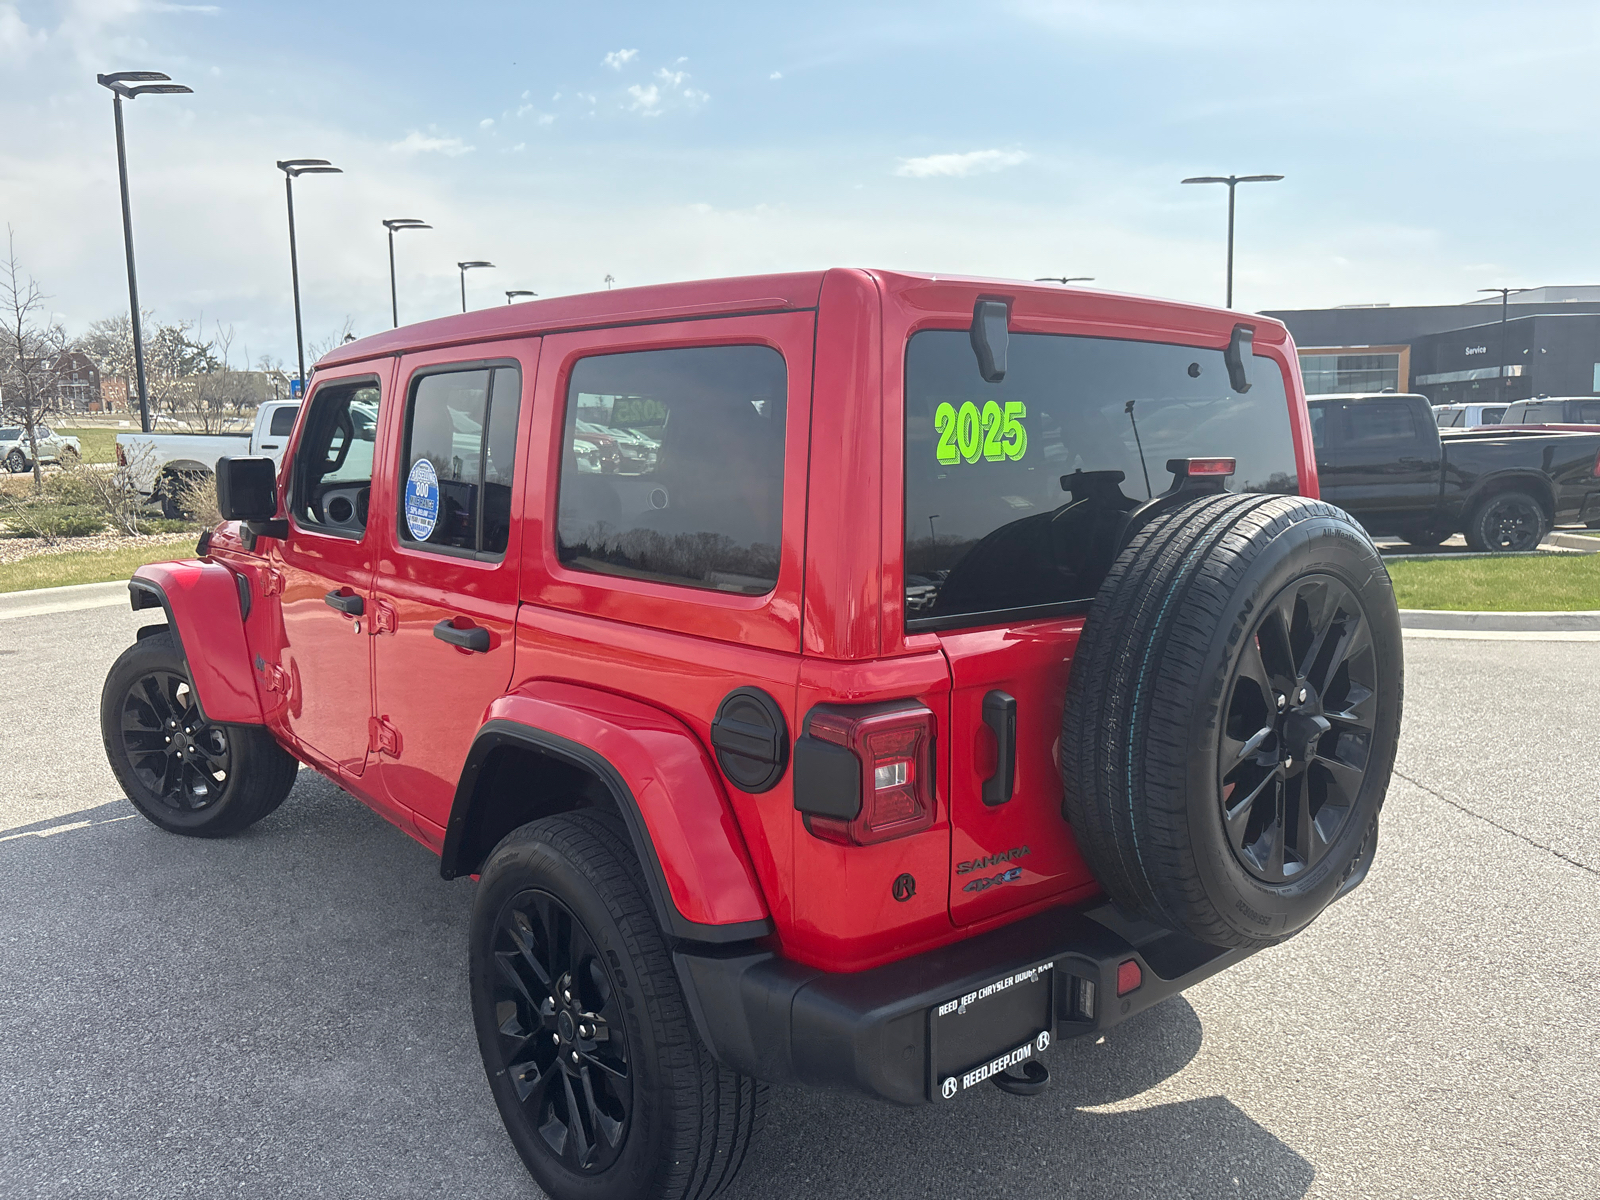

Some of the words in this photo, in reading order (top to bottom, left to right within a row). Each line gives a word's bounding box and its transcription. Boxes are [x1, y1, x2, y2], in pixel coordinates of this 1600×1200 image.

[1465, 346, 1487, 355] Service
[935, 400, 1028, 465] 2025
[415, 481, 429, 498] 800
[409, 495, 420, 506] MILE
[420, 497, 434, 510] RANGE
[1322, 528, 1361, 547] All-Weather
[956, 845, 1031, 875] SAHARA
[939, 1000, 958, 1016] REED
[961, 992, 977, 1006] JEEP
[979, 976, 1014, 999] CHRYSLER
[963, 1044, 1032, 1090] REEDJEEP.COM
